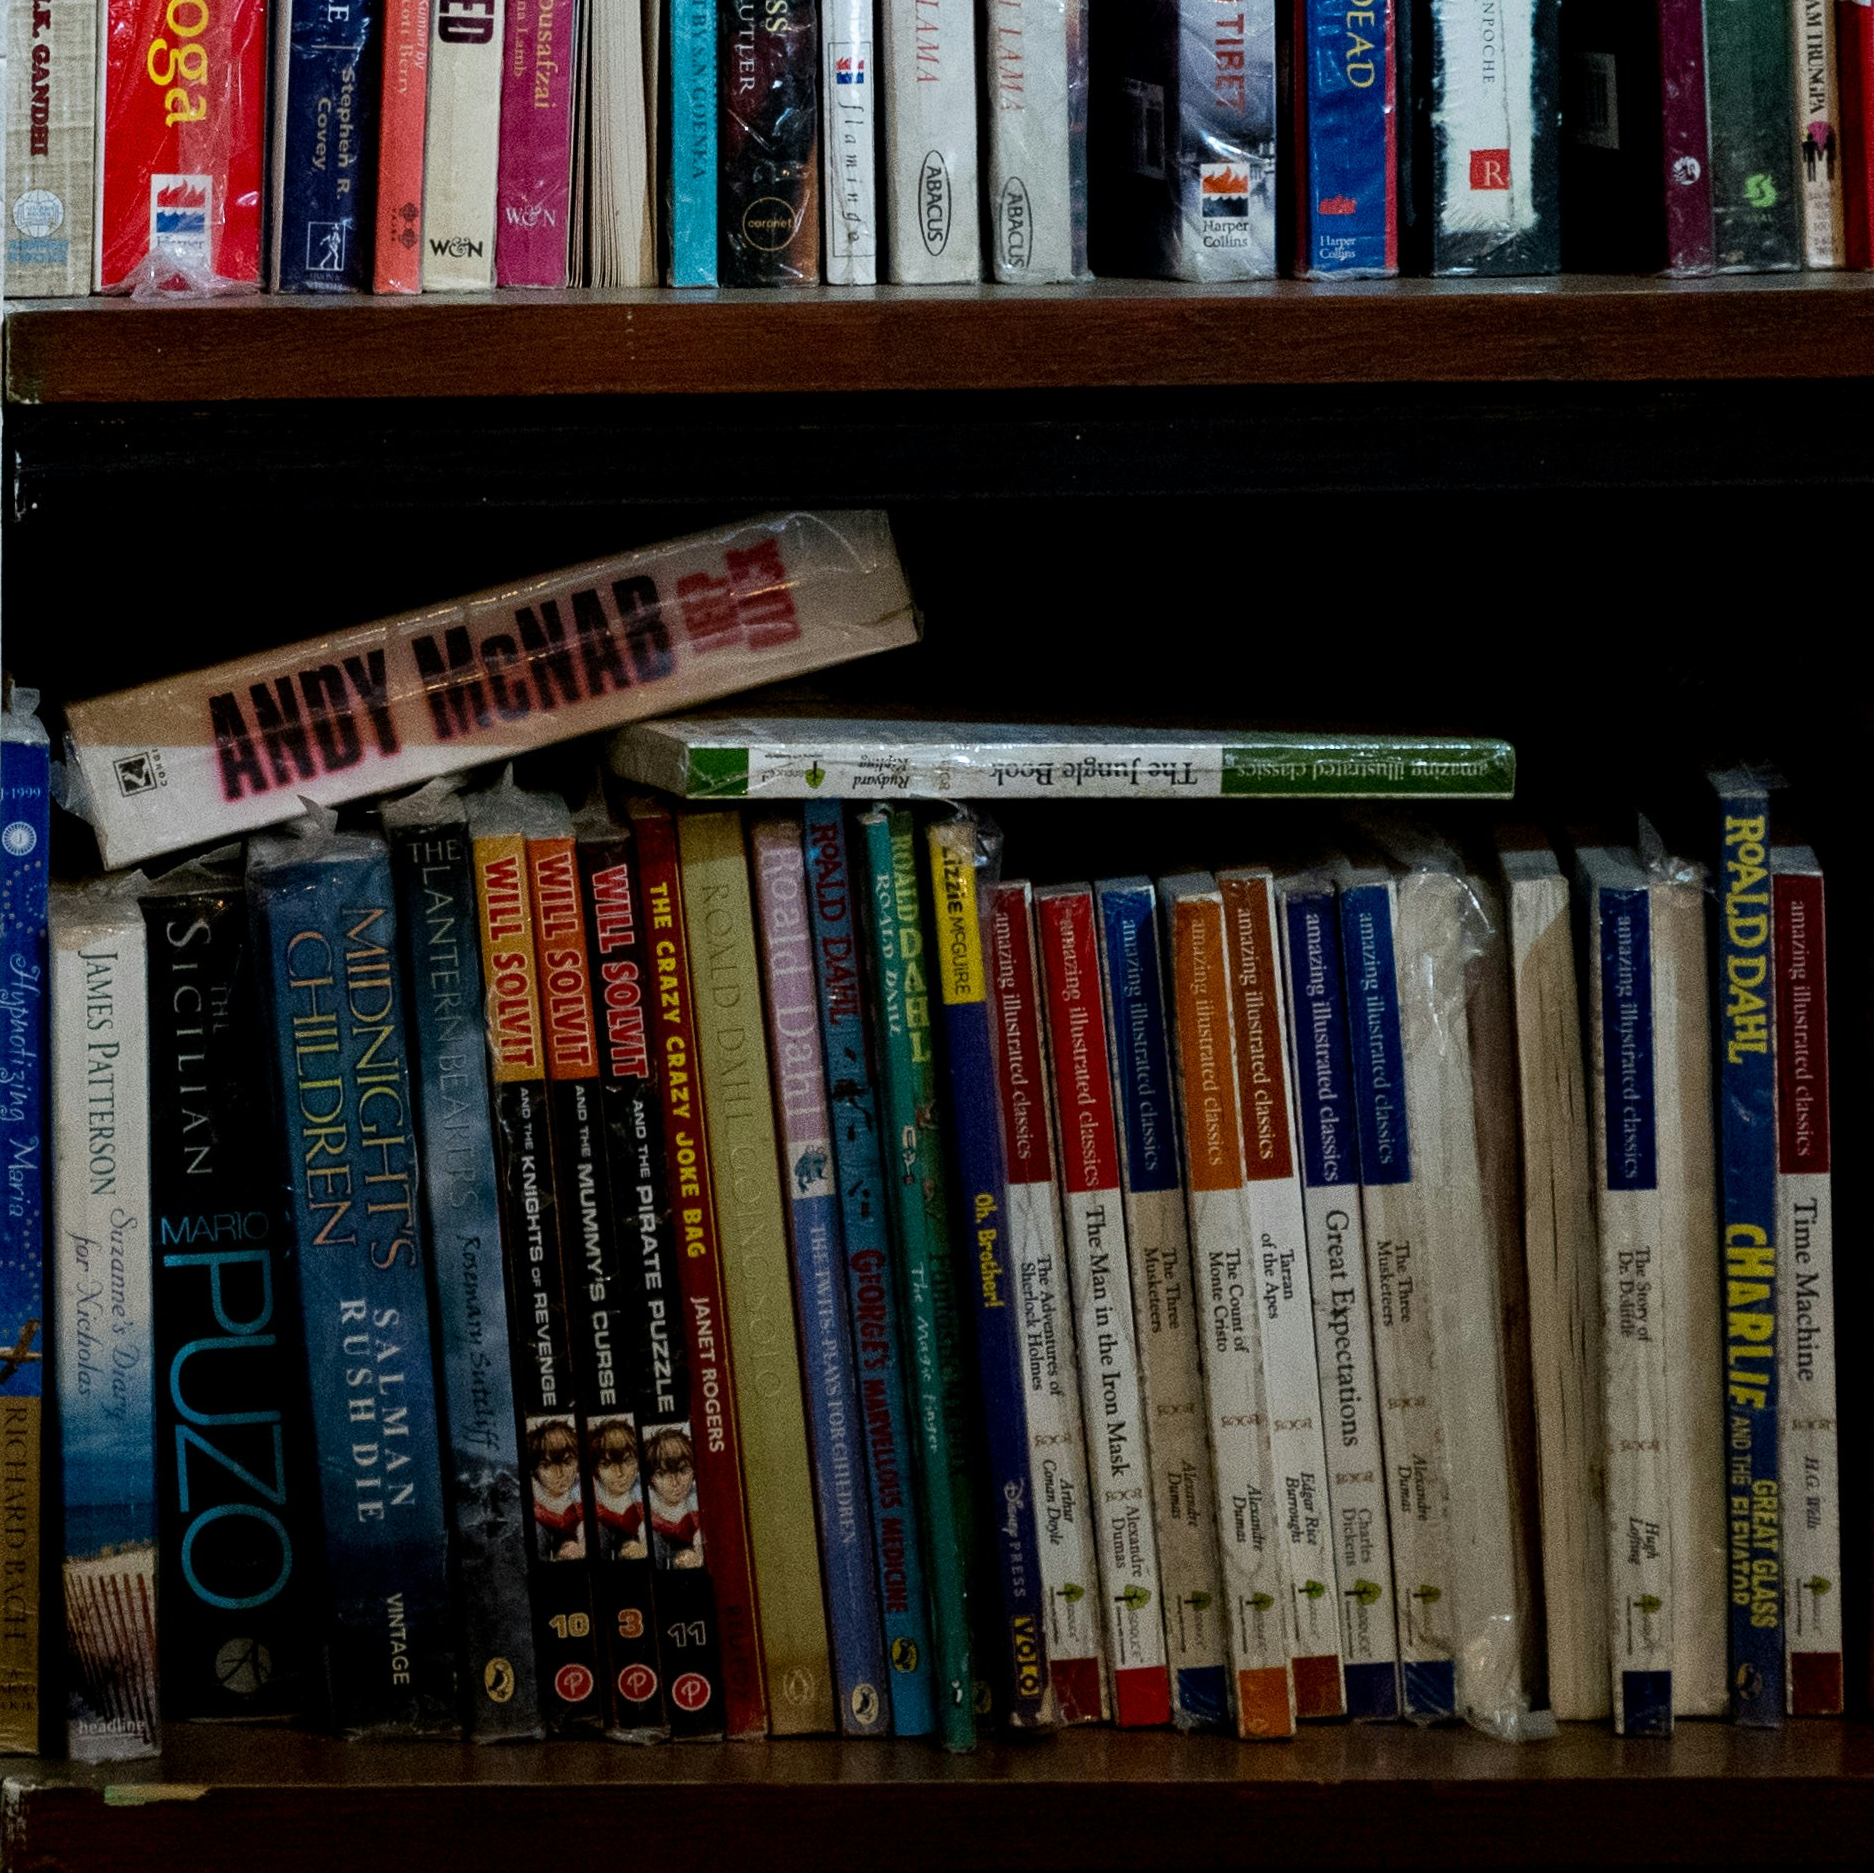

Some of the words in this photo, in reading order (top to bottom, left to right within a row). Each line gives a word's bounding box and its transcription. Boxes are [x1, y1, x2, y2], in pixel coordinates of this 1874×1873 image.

[1215, 14, 1245, 116] TIBET
[928, 166, 945, 242] ABACUS
[208, 648, 402, 804] ANDY
[991, 760, 1053, 786] Book
[1064, 756, 1145, 786] Jungle
[1154, 759, 1198, 786] The
[1236, 763, 1304, 781] classics
[1311, 762, 1405, 781] illustrated
[484, 856, 525, 942] WILL
[1726, 816, 1768, 948] ROALD
[79, 950, 119, 1034] JAMES
[492, 952, 536, 1071] SOLVIT
[1727, 956, 1768, 1065] DAHL
[166, 920, 213, 1174] SICILIAN
[287, 931, 356, 1246] CHILDREN
[343, 908, 417, 1271] MIDNIGHT'S
[87, 1042, 119, 1196] PATTERSON
[162, 1214, 269, 1243] MARIO
[1326, 1208, 1350, 1277] Great
[690, 1297, 716, 1361] JANET
[1725, 1224, 1776, 1410] CHARLIE
[339, 1298, 386, 1524] RUSHDIE
[372, 1306, 416, 1509] SALMAN
[701, 1369, 725, 1453] ROGERS
[1329, 1284, 1359, 1447] Expectations
[164, 1250, 292, 1610] PUZO
[548, 1613, 590, 1638] 10
[618, 1608, 644, 1637] 3
